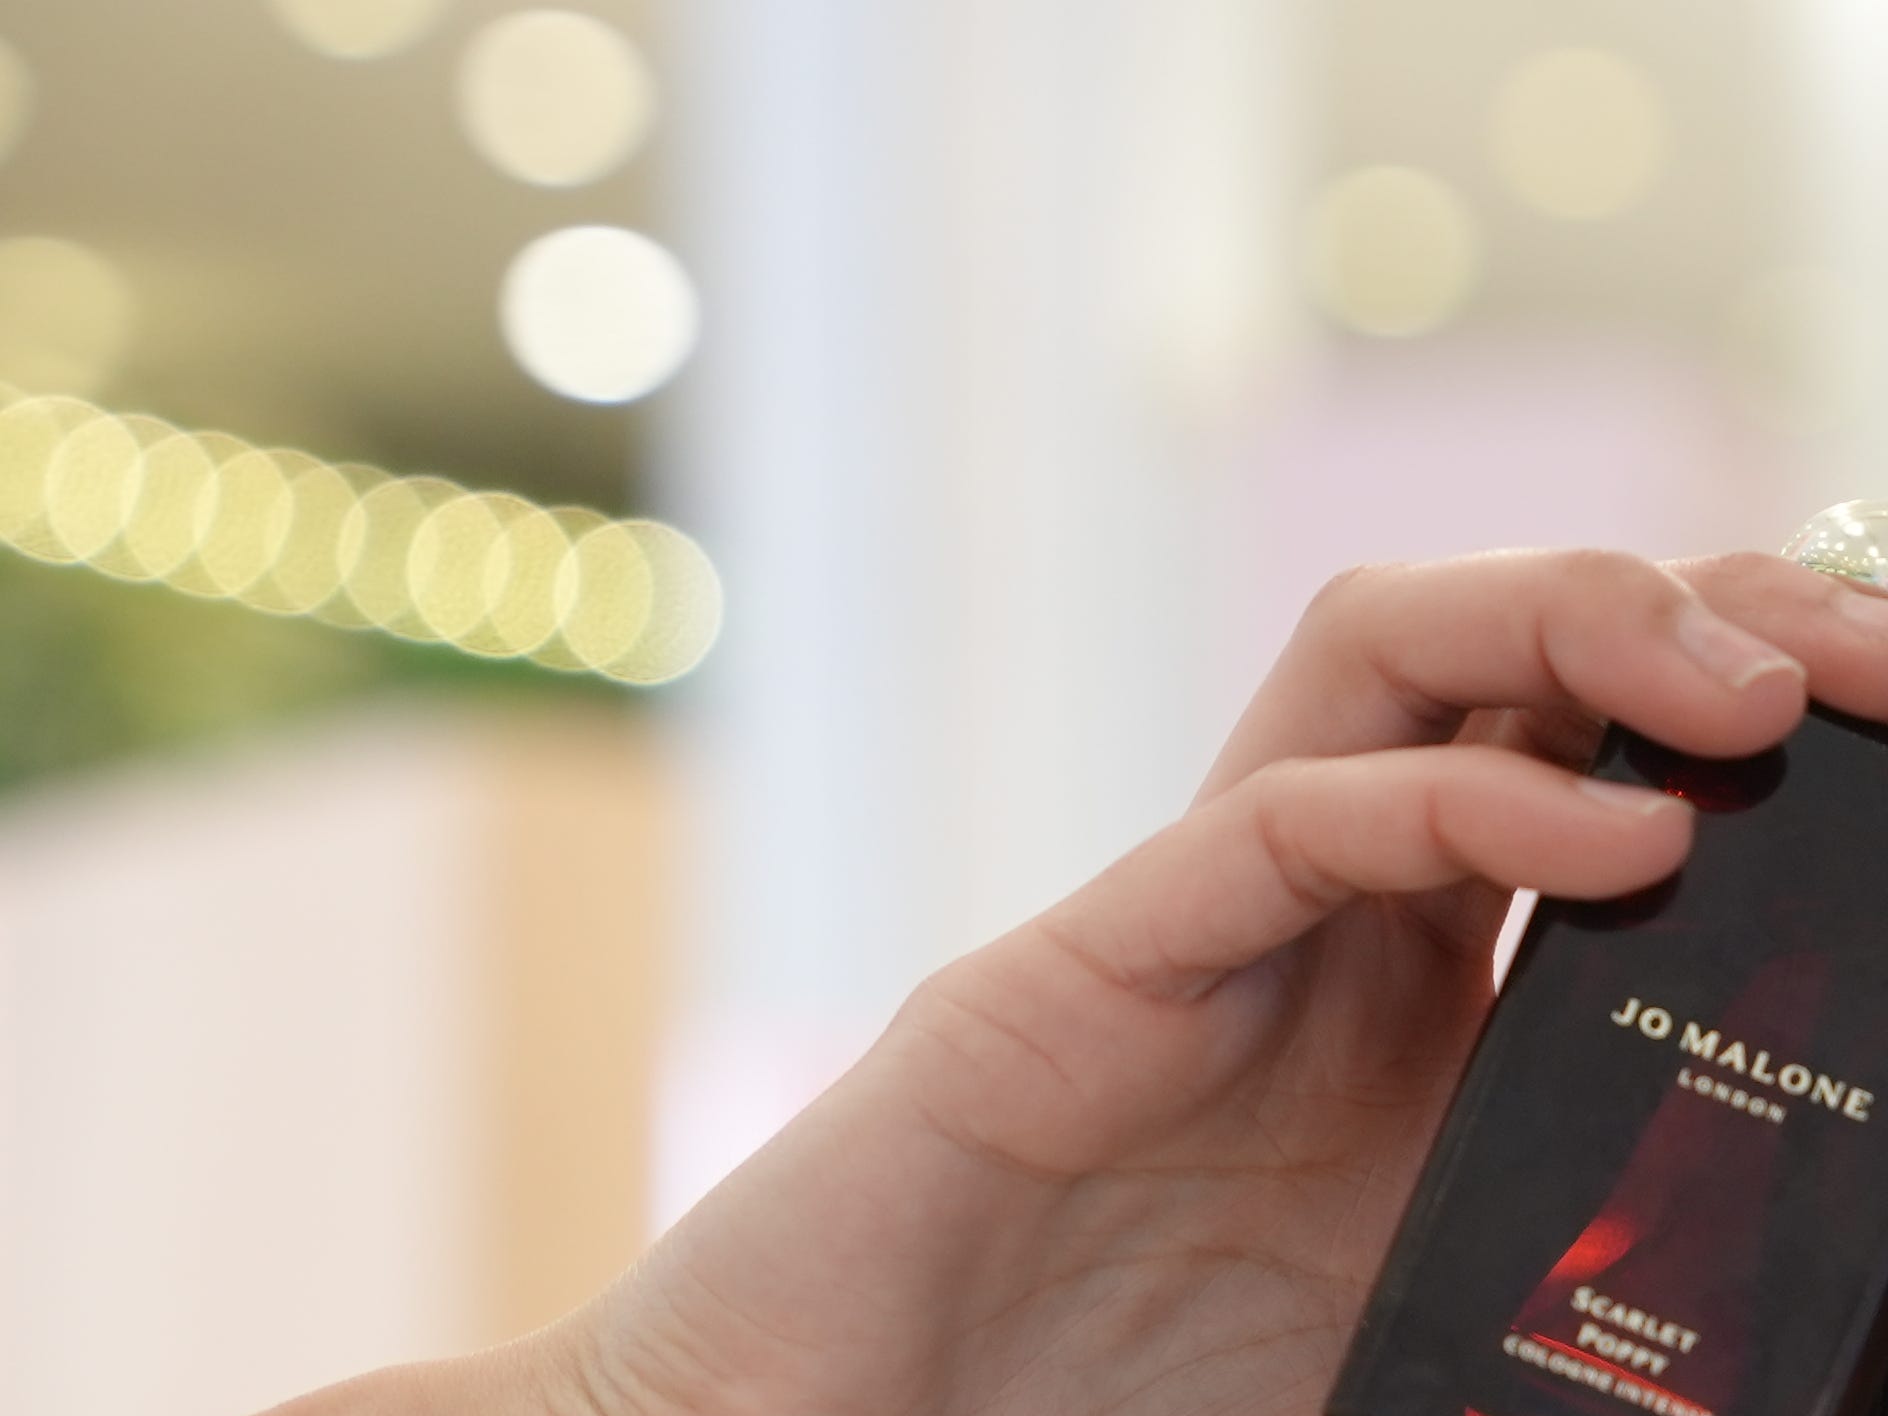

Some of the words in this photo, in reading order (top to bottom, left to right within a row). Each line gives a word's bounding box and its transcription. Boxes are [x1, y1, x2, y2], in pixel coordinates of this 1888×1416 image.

[1611, 998, 1672, 1039] JO
[1679, 1022, 1875, 1121] MALONE
[1677, 1067, 1787, 1124] LONDON
[1571, 1286, 1700, 1353] SCARLET
